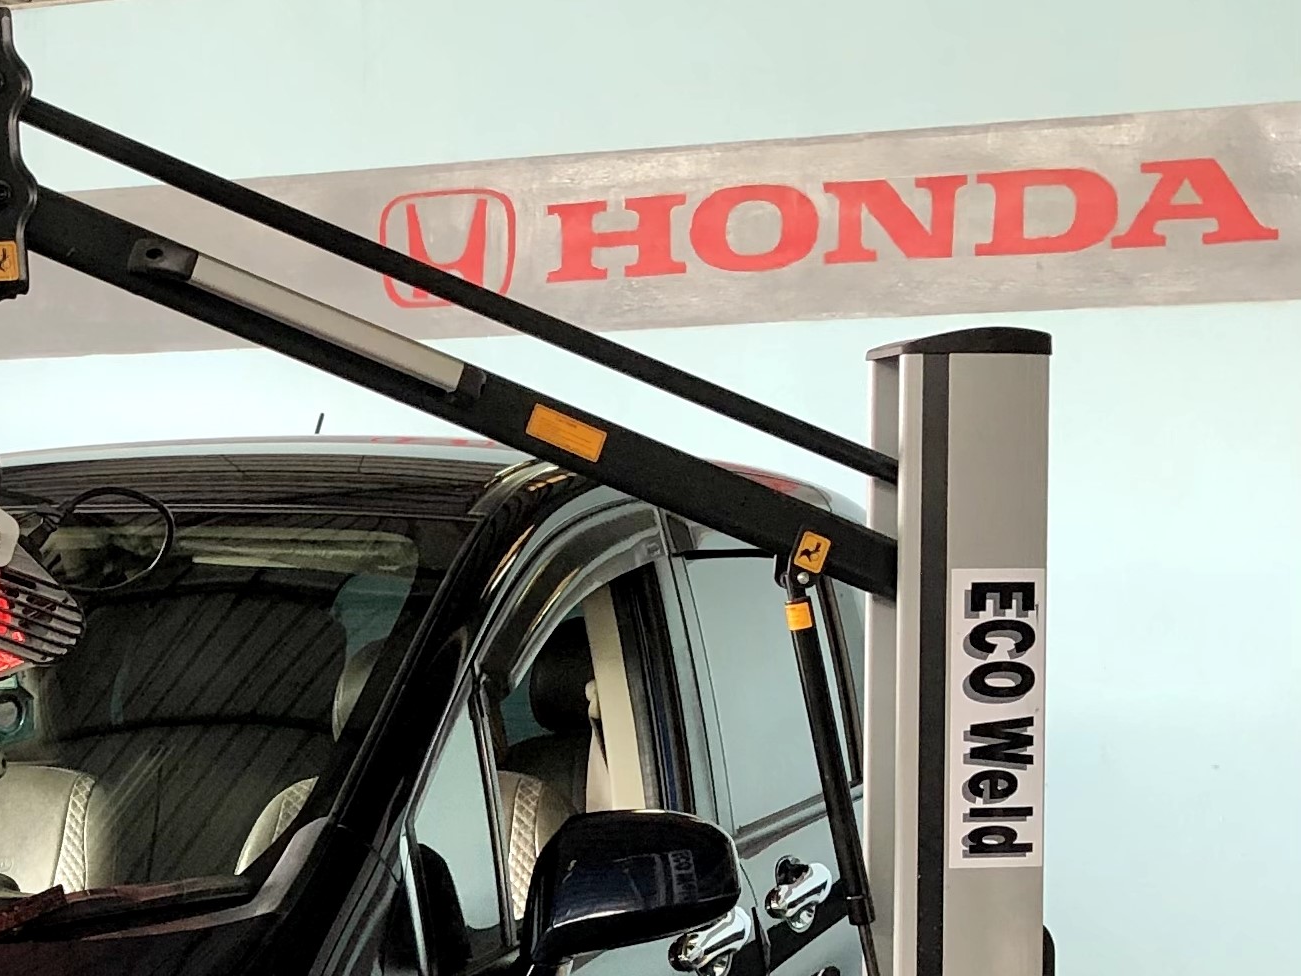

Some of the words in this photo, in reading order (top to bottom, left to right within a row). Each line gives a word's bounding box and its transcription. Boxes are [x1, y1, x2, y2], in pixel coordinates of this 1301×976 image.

[547, 157, 1279, 284] HONDA
[963, 581, 1036, 704] ECO
[962, 716, 1035, 859] Weld
